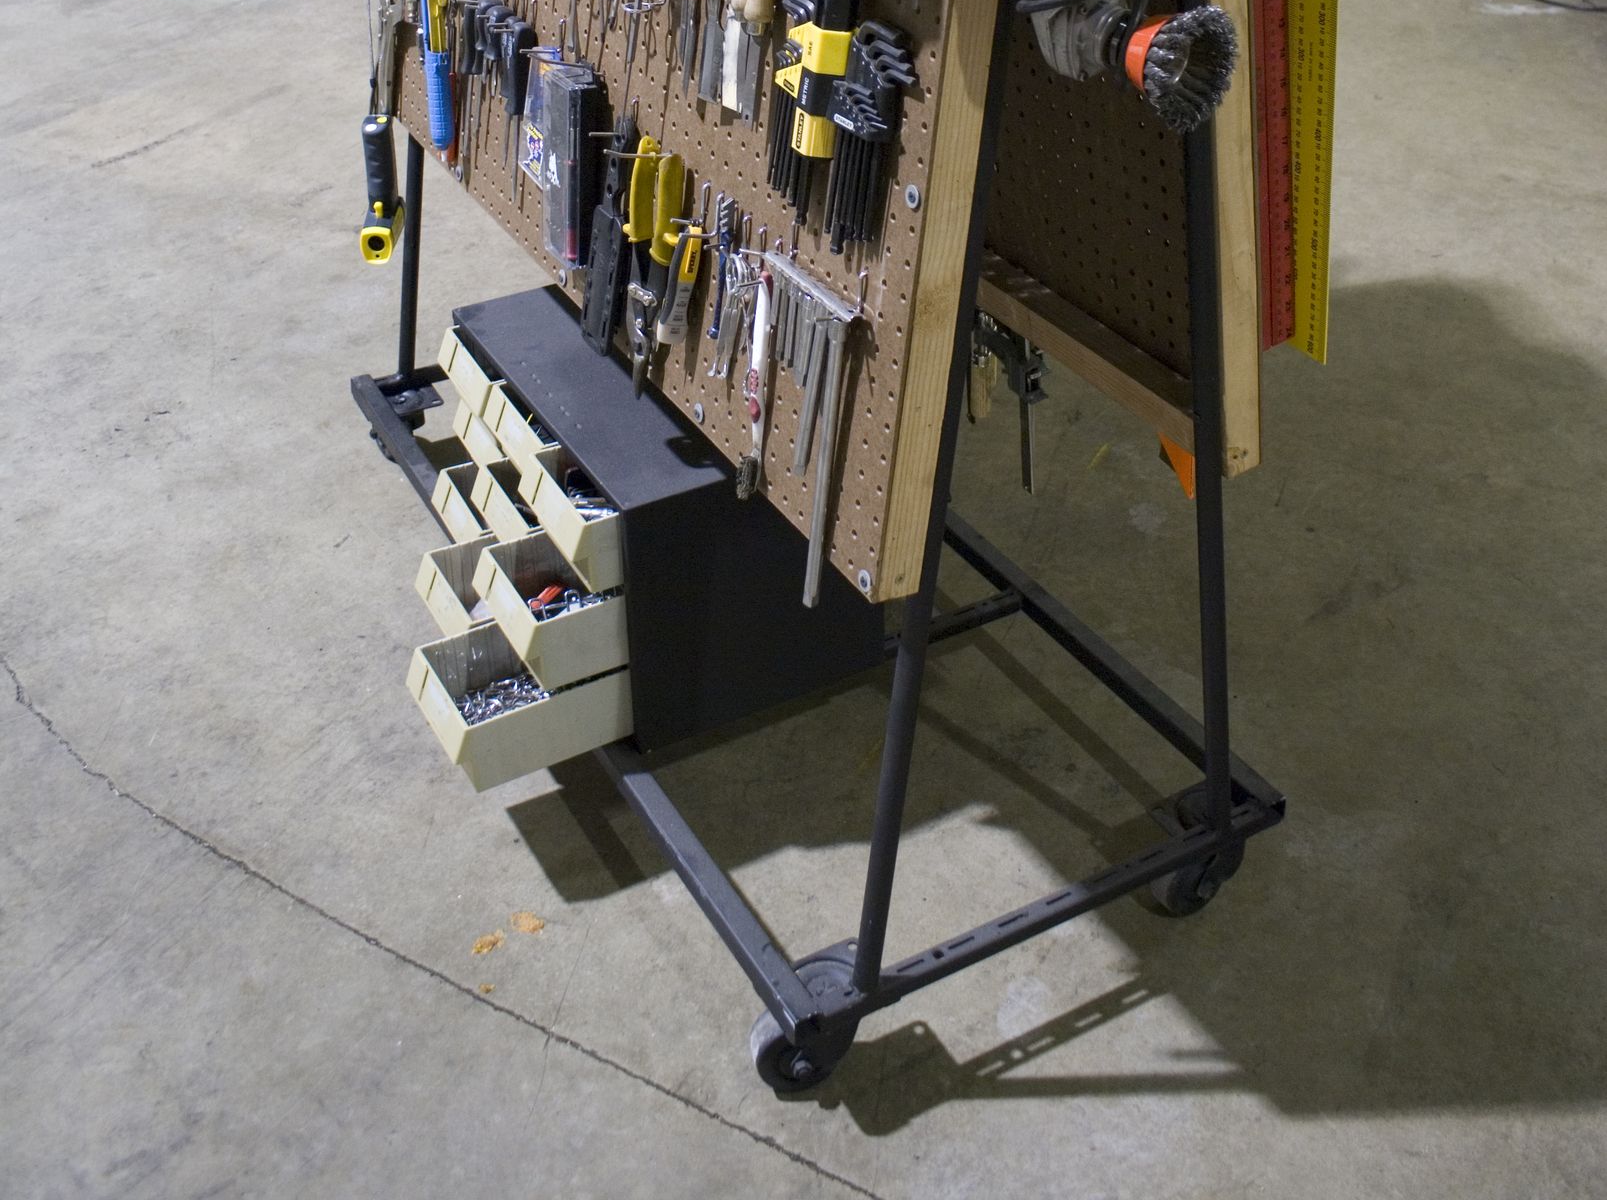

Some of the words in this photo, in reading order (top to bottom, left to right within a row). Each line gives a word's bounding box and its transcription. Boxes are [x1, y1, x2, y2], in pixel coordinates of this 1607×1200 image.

[1297, 47, 1305, 61] 300
[801, 76, 809, 106] METRIC
[1311, 238, 1319, 251] 500
